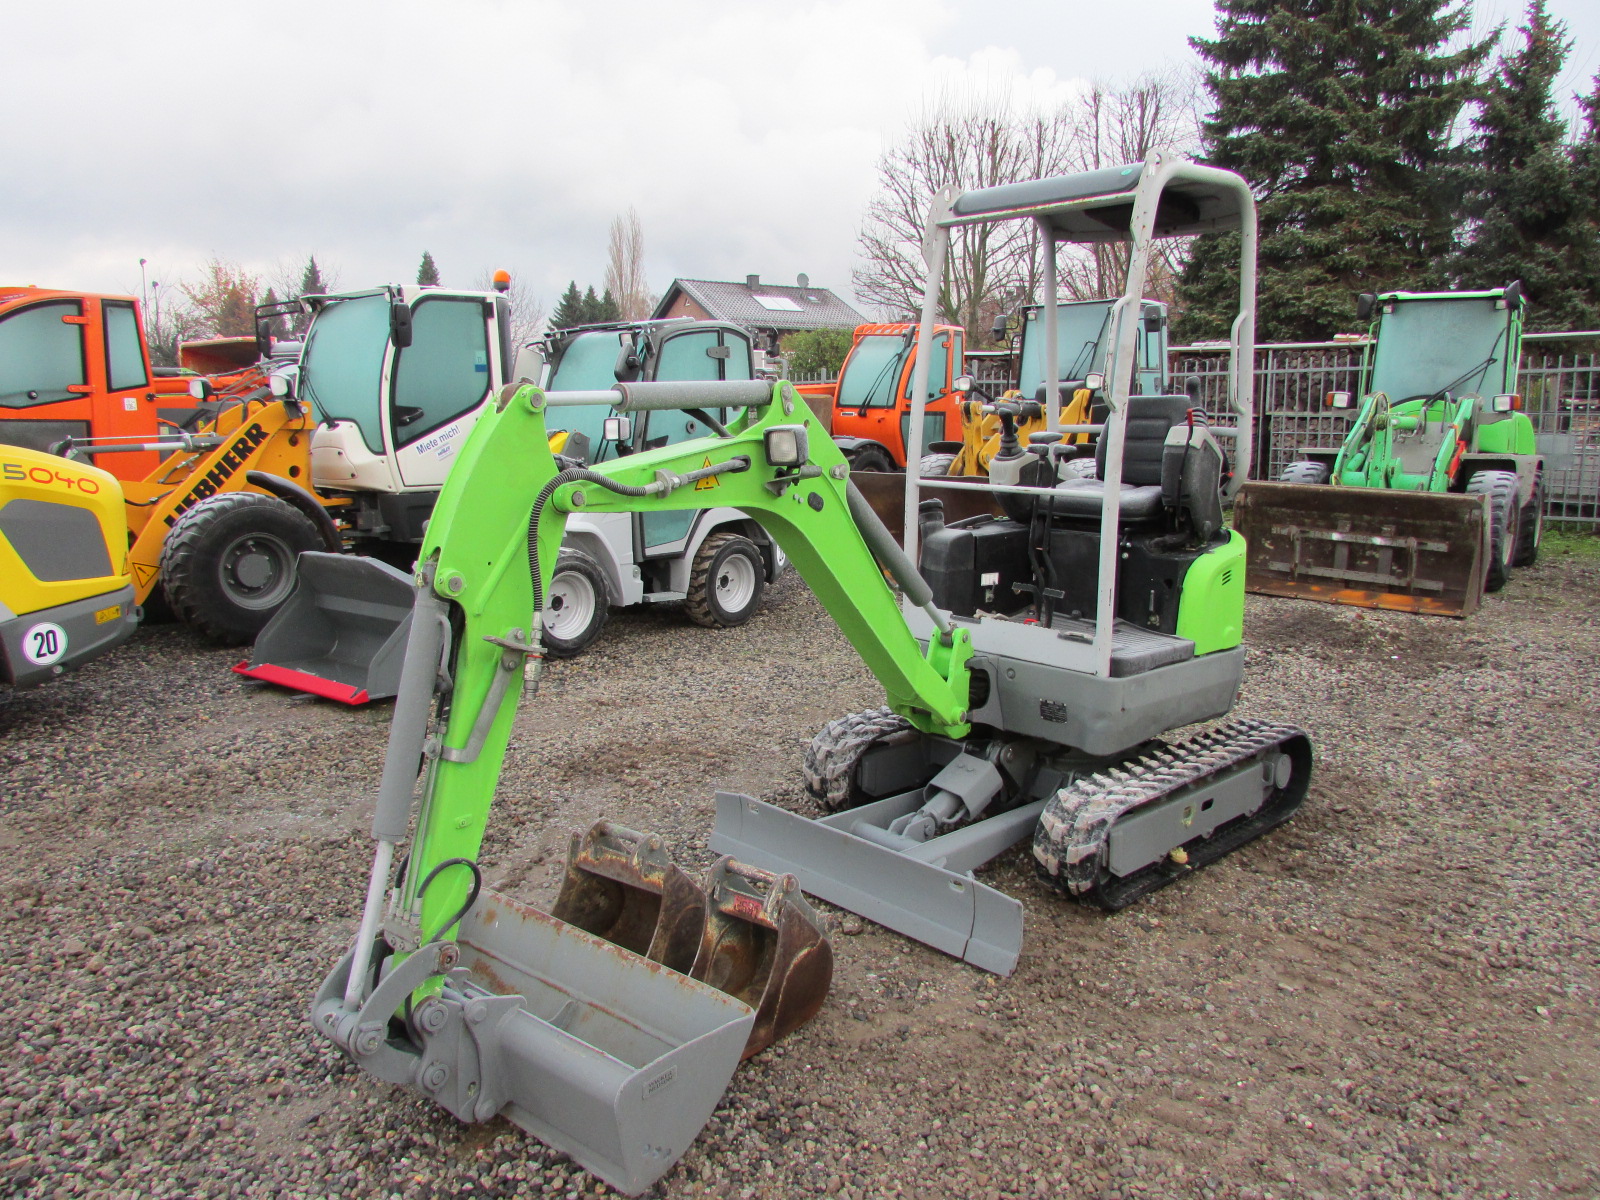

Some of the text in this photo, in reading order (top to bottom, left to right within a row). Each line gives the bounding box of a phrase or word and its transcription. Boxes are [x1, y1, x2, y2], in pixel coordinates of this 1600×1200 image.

[416, 438, 439, 455] Miete
[438, 424, 461, 443] mich!
[2, 463, 100, 495] 5040
[33, 629, 59, 658] 20
